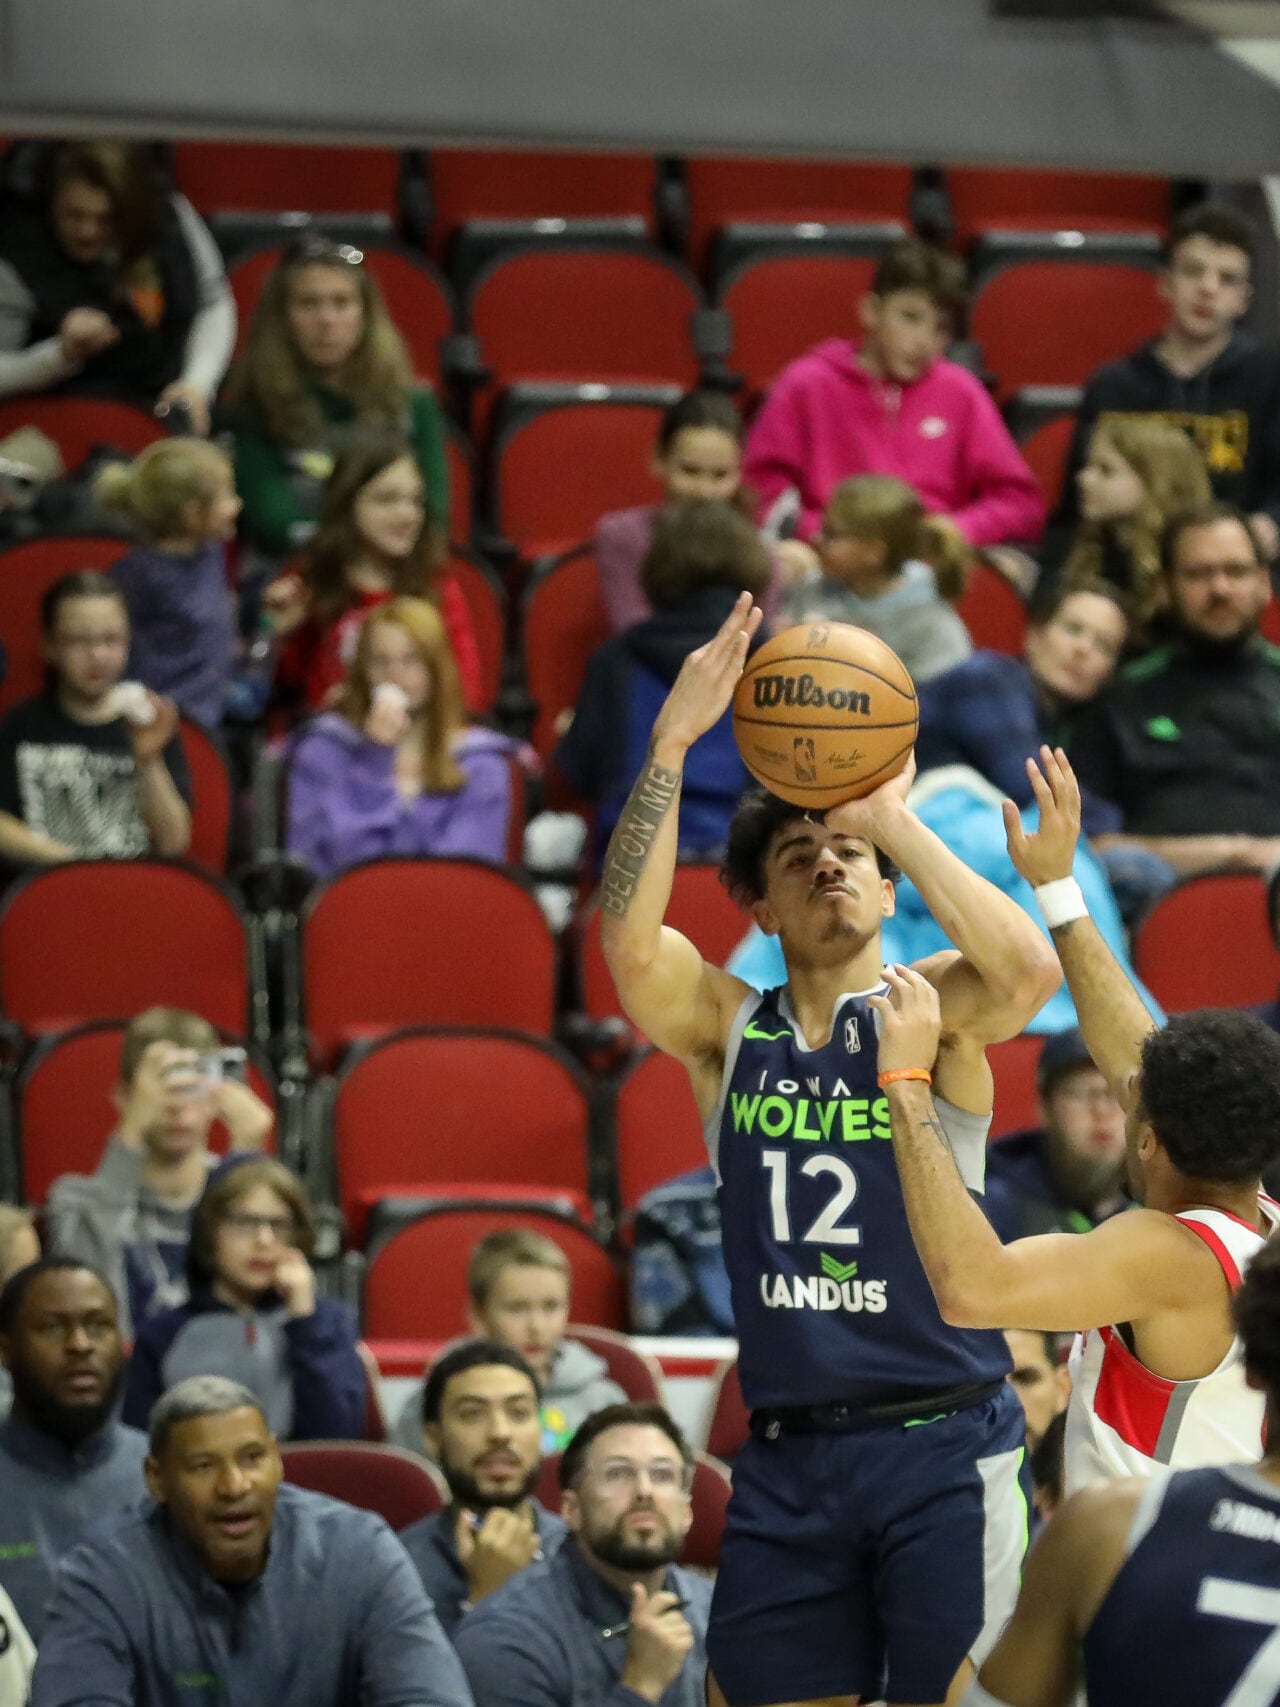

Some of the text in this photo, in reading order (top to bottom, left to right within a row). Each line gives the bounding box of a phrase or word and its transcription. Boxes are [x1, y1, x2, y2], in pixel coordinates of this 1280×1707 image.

[753, 673, 871, 716] Wilson
[605, 766, 680, 915] BET ON ME
[759, 1070, 852, 1097] IOWA
[732, 1092, 892, 1142] WOLVES
[761, 1149, 861, 1245] 12
[761, 1273, 888, 1313] LANDUS
